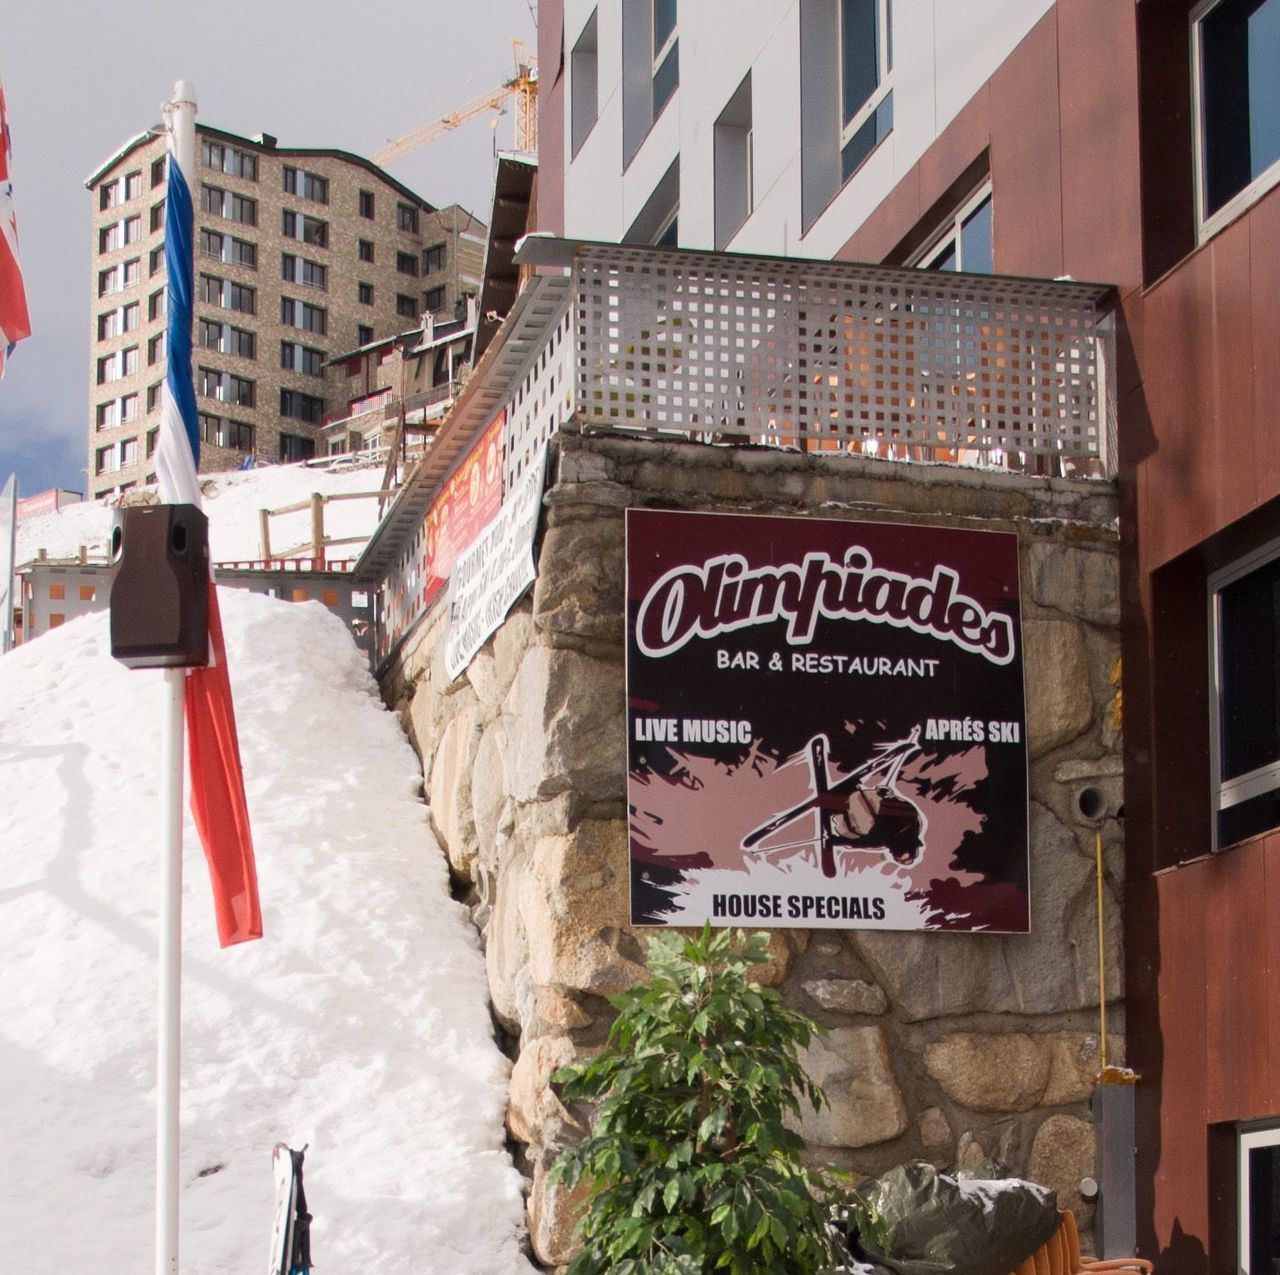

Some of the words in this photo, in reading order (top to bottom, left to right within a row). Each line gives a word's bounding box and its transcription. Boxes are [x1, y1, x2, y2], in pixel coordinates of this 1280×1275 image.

[636, 546, 1015, 665] Olimpiades
[717, 650, 760, 670] BAR
[768, 653, 783, 672] &
[792, 654, 939, 677] RESTAURANT
[636, 718, 679, 742] LIVE
[682, 719, 752, 744] MUSIC
[925, 716, 985, 742] APRÉS
[988, 721, 1020, 743] SKI
[713, 894, 783, 918] HOUSE
[787, 895, 886, 920] SPECIALS
